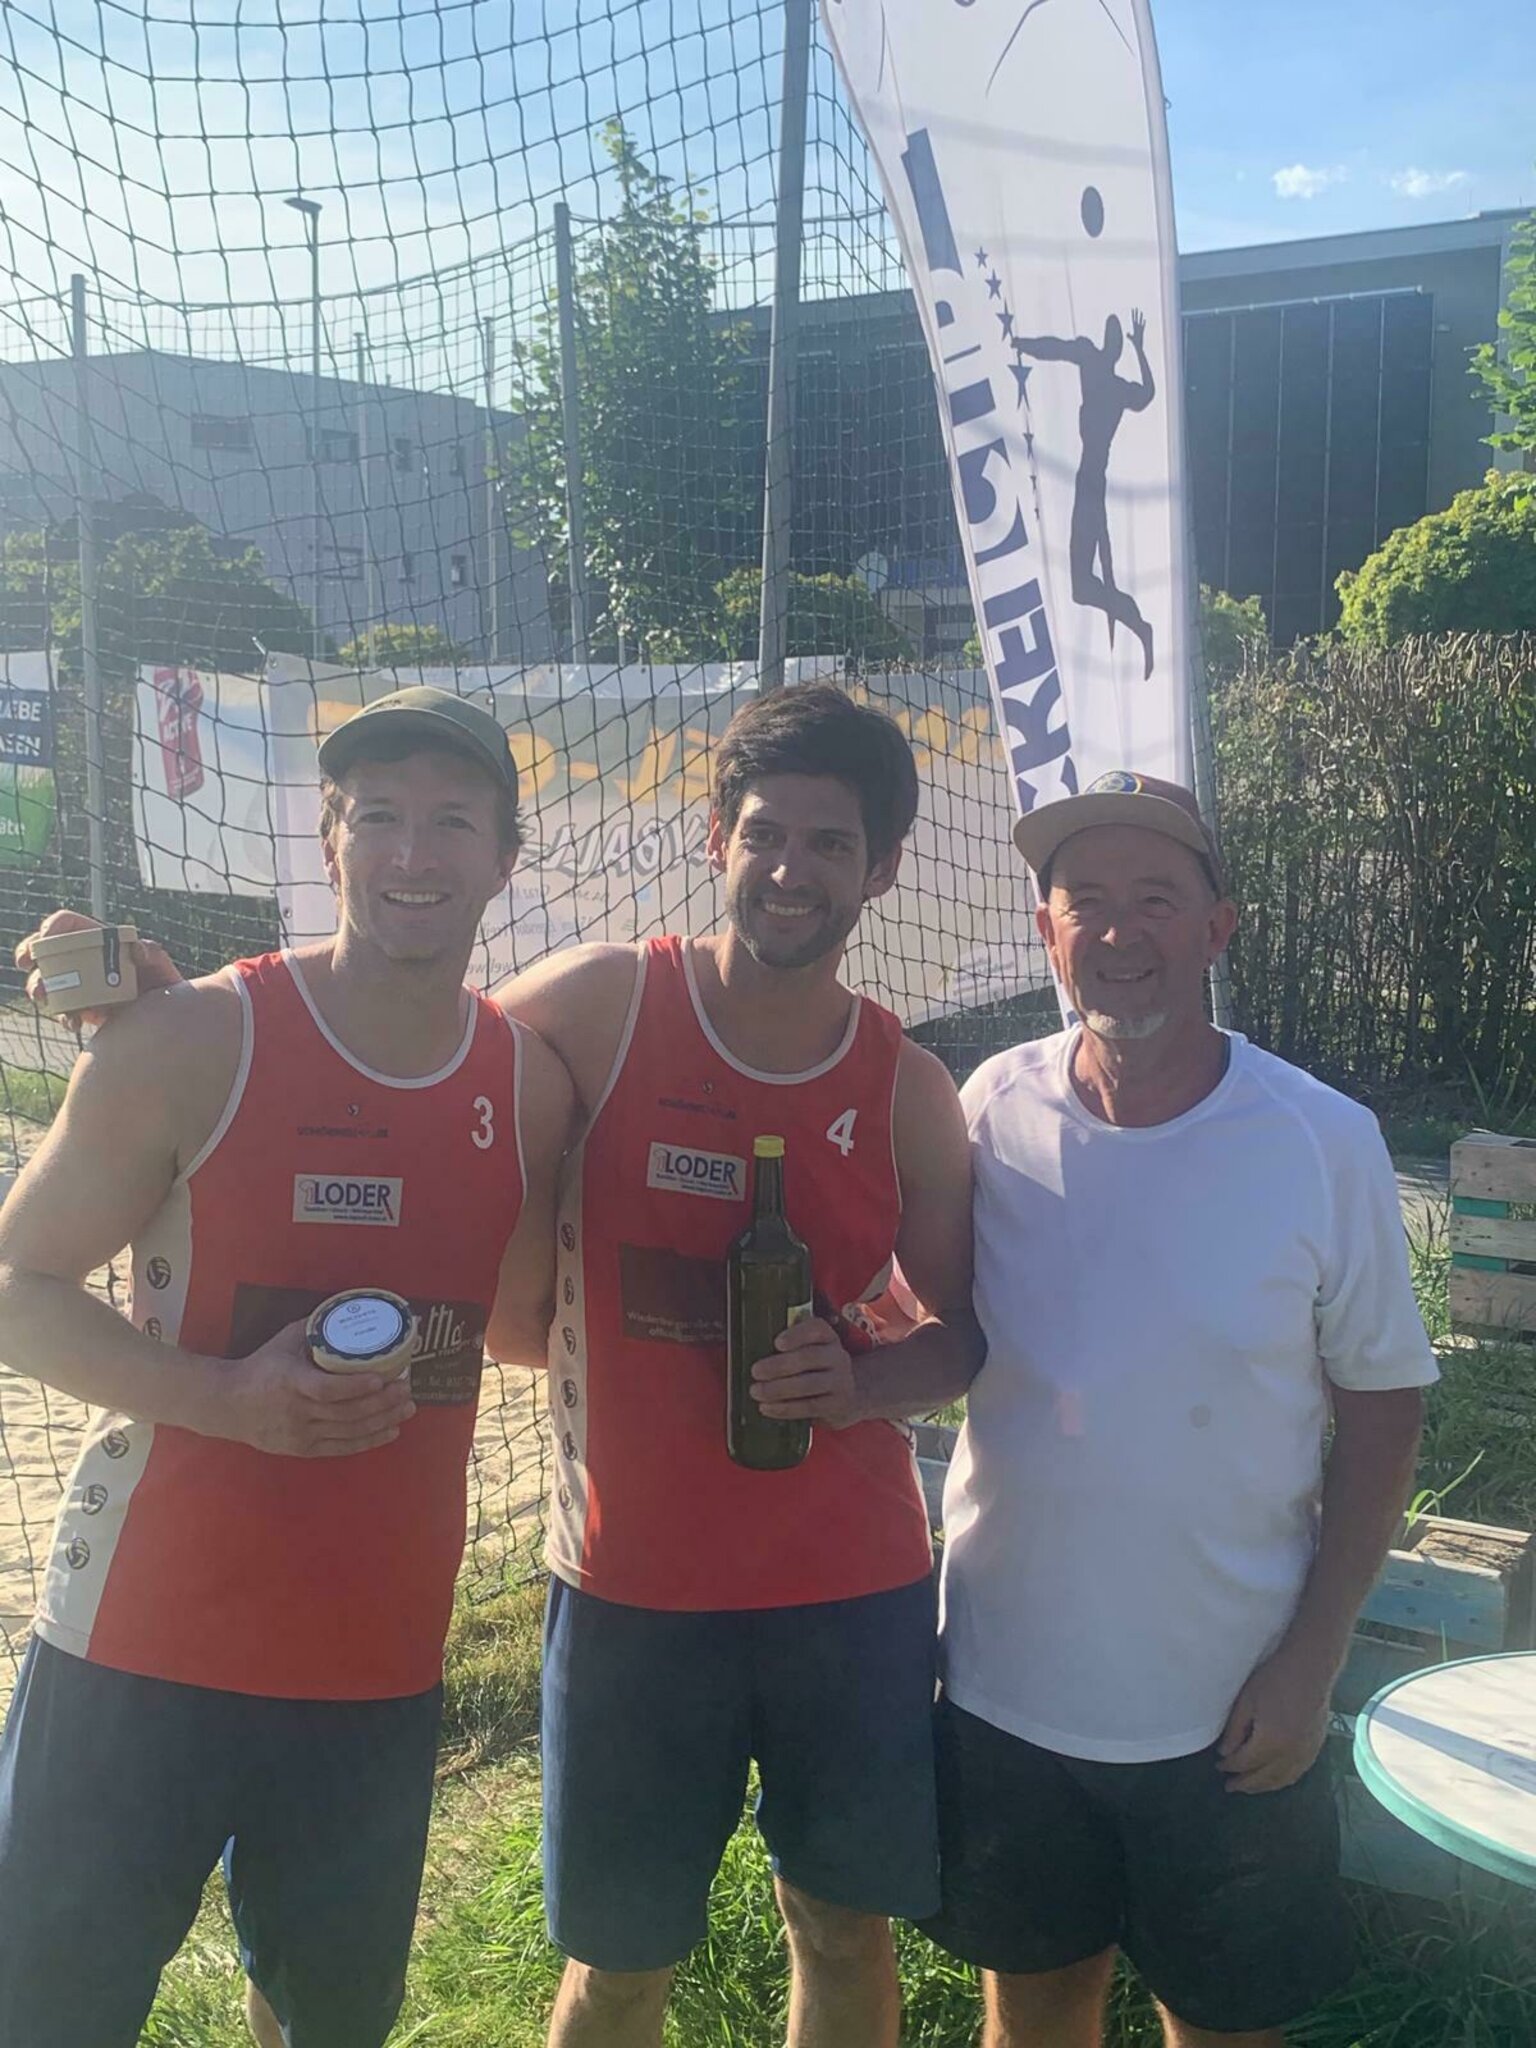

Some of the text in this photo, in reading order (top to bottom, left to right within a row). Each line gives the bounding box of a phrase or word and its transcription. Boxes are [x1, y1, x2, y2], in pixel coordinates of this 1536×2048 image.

[471, 1095, 495, 1150] 3
[826, 1109, 858, 1157] 4
[665, 1151, 738, 1188] LODER
[314, 1181, 392, 1213] LODER
